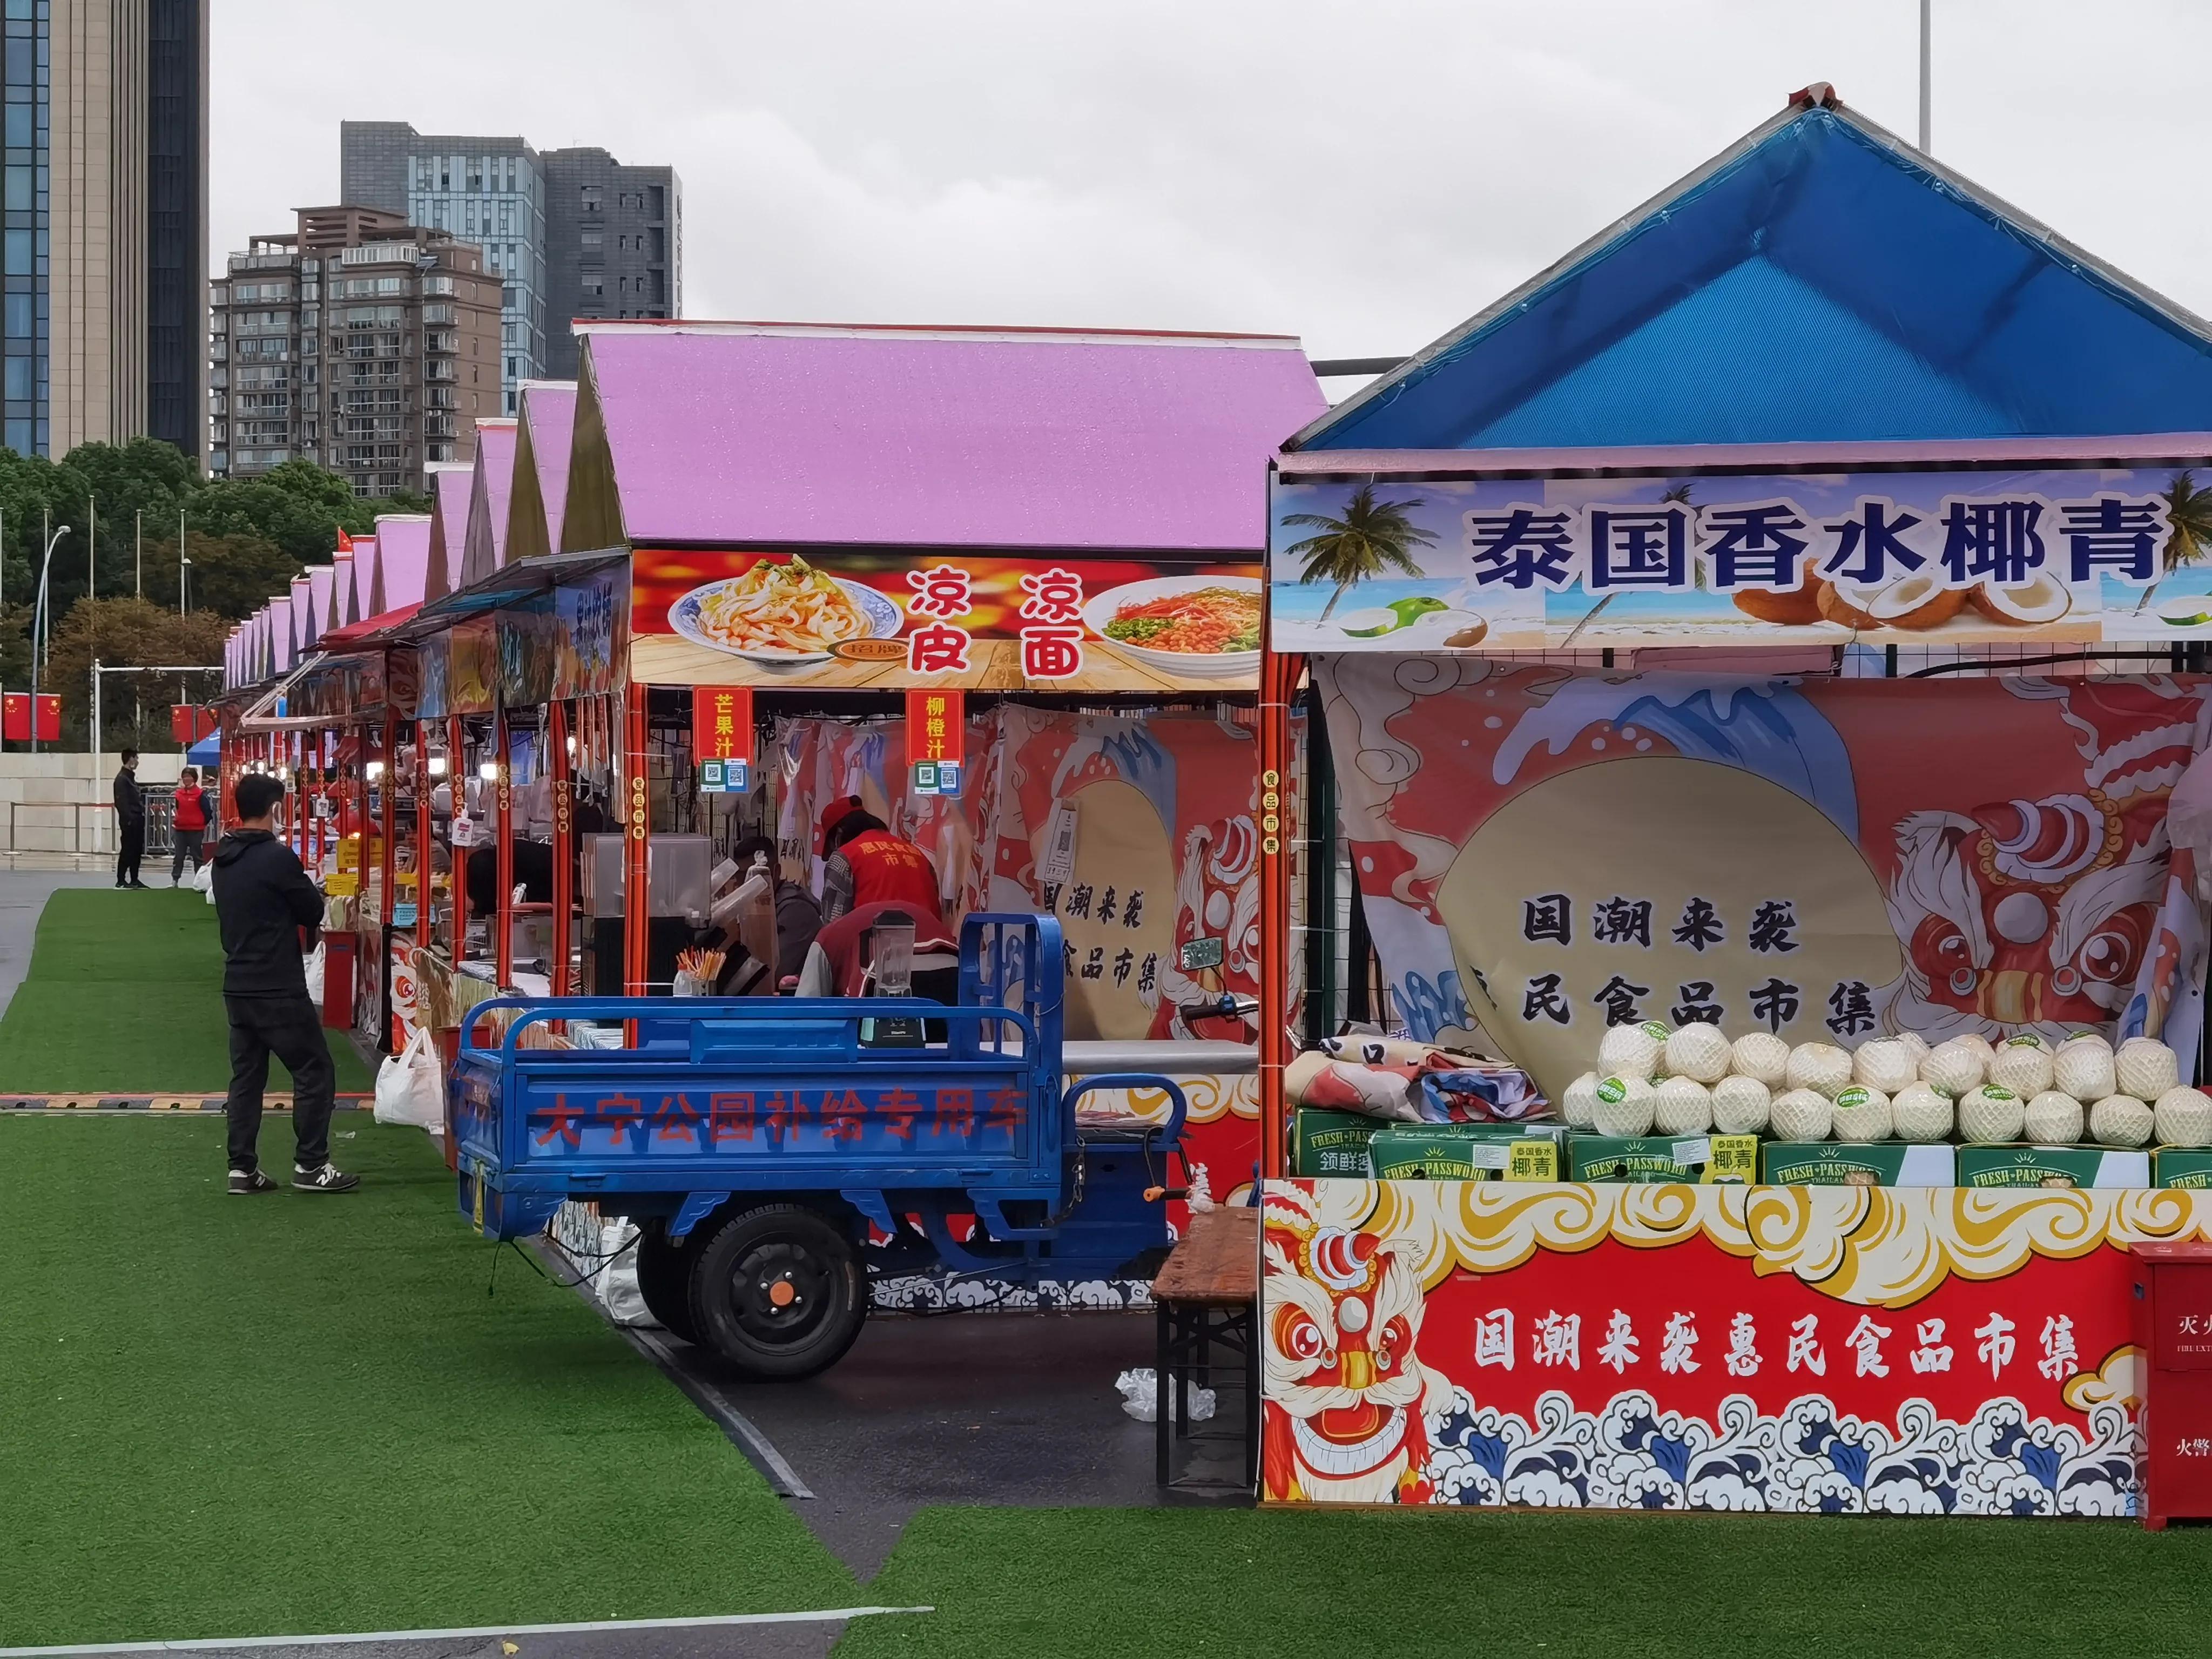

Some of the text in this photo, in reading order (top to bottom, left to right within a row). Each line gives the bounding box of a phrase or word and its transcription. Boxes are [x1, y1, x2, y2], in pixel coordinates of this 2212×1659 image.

[1470, 498, 2166, 589] 泰国香水椰青
[908, 566, 970, 673] 凉皮
[1021, 569, 1083, 678] 凉面
[714, 693, 734, 757] 芒果汁
[926, 696, 946, 759] 柳橙汁
[1264, 771, 1278, 853] 食品市集
[1044, 882, 1144, 929] 国潮来袭
[1522, 893, 1800, 954] 国潮来袭
[1470, 965, 1876, 1036] 民食品市集
[536, 1088, 1028, 1146] 大宁公园补给专用车
[1311, 1131, 1344, 1149] FRESH
[1512, 1157, 1552, 1177] 椰青
[1516, 1147, 1552, 1156] 泰国香水
[1713, 1149, 1753, 1170] 椰青
[1717, 1140, 1753, 1149] 泰国香水
[1425, 1162, 1486, 1181] PASSWORD
[1777, 1164, 1815, 1183] FRESH
[1972, 1170, 2010, 1188] FRESH
[2168, 1174, 2207, 1189] FRESH
[1474, 1308, 2080, 1382] 国潮来袭惠民食品市集
[2176, 1438, 2210, 1457] 火警
